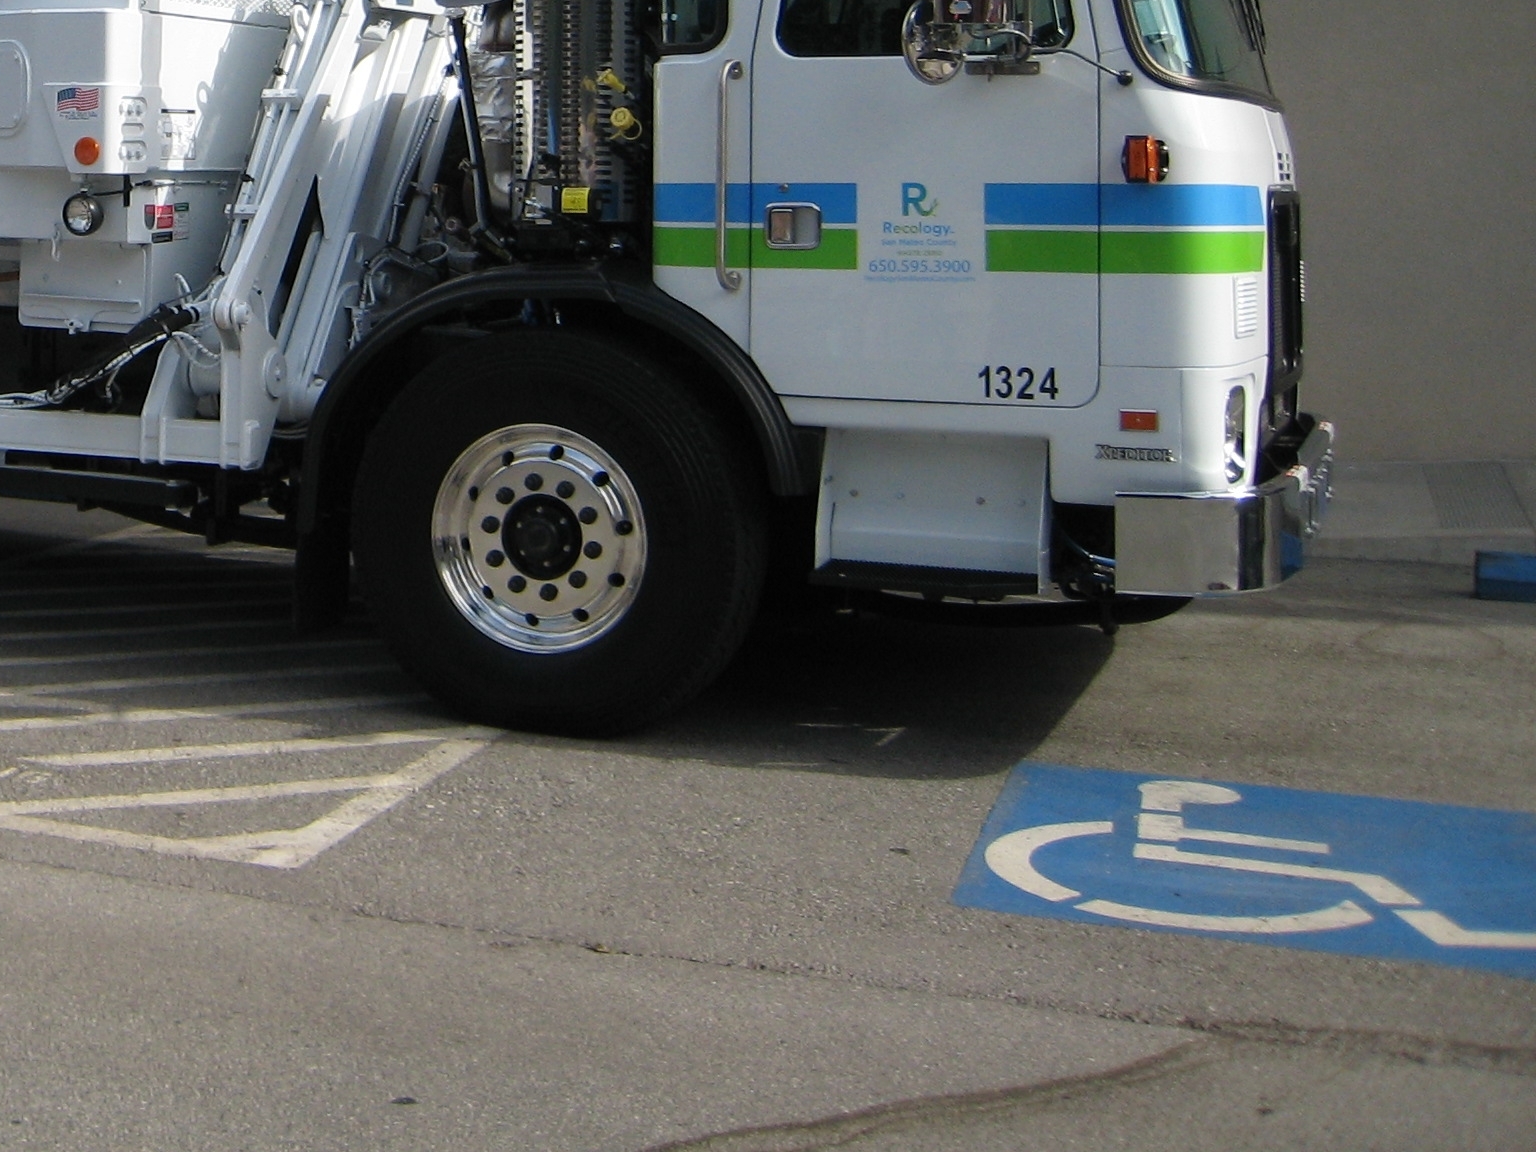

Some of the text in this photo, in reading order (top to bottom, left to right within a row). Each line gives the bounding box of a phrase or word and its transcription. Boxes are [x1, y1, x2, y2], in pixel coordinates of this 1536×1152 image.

[882, 221, 951, 237] Recology
[869, 259, 971, 273] 650.595.3900
[978, 365, 1059, 399] 1324
